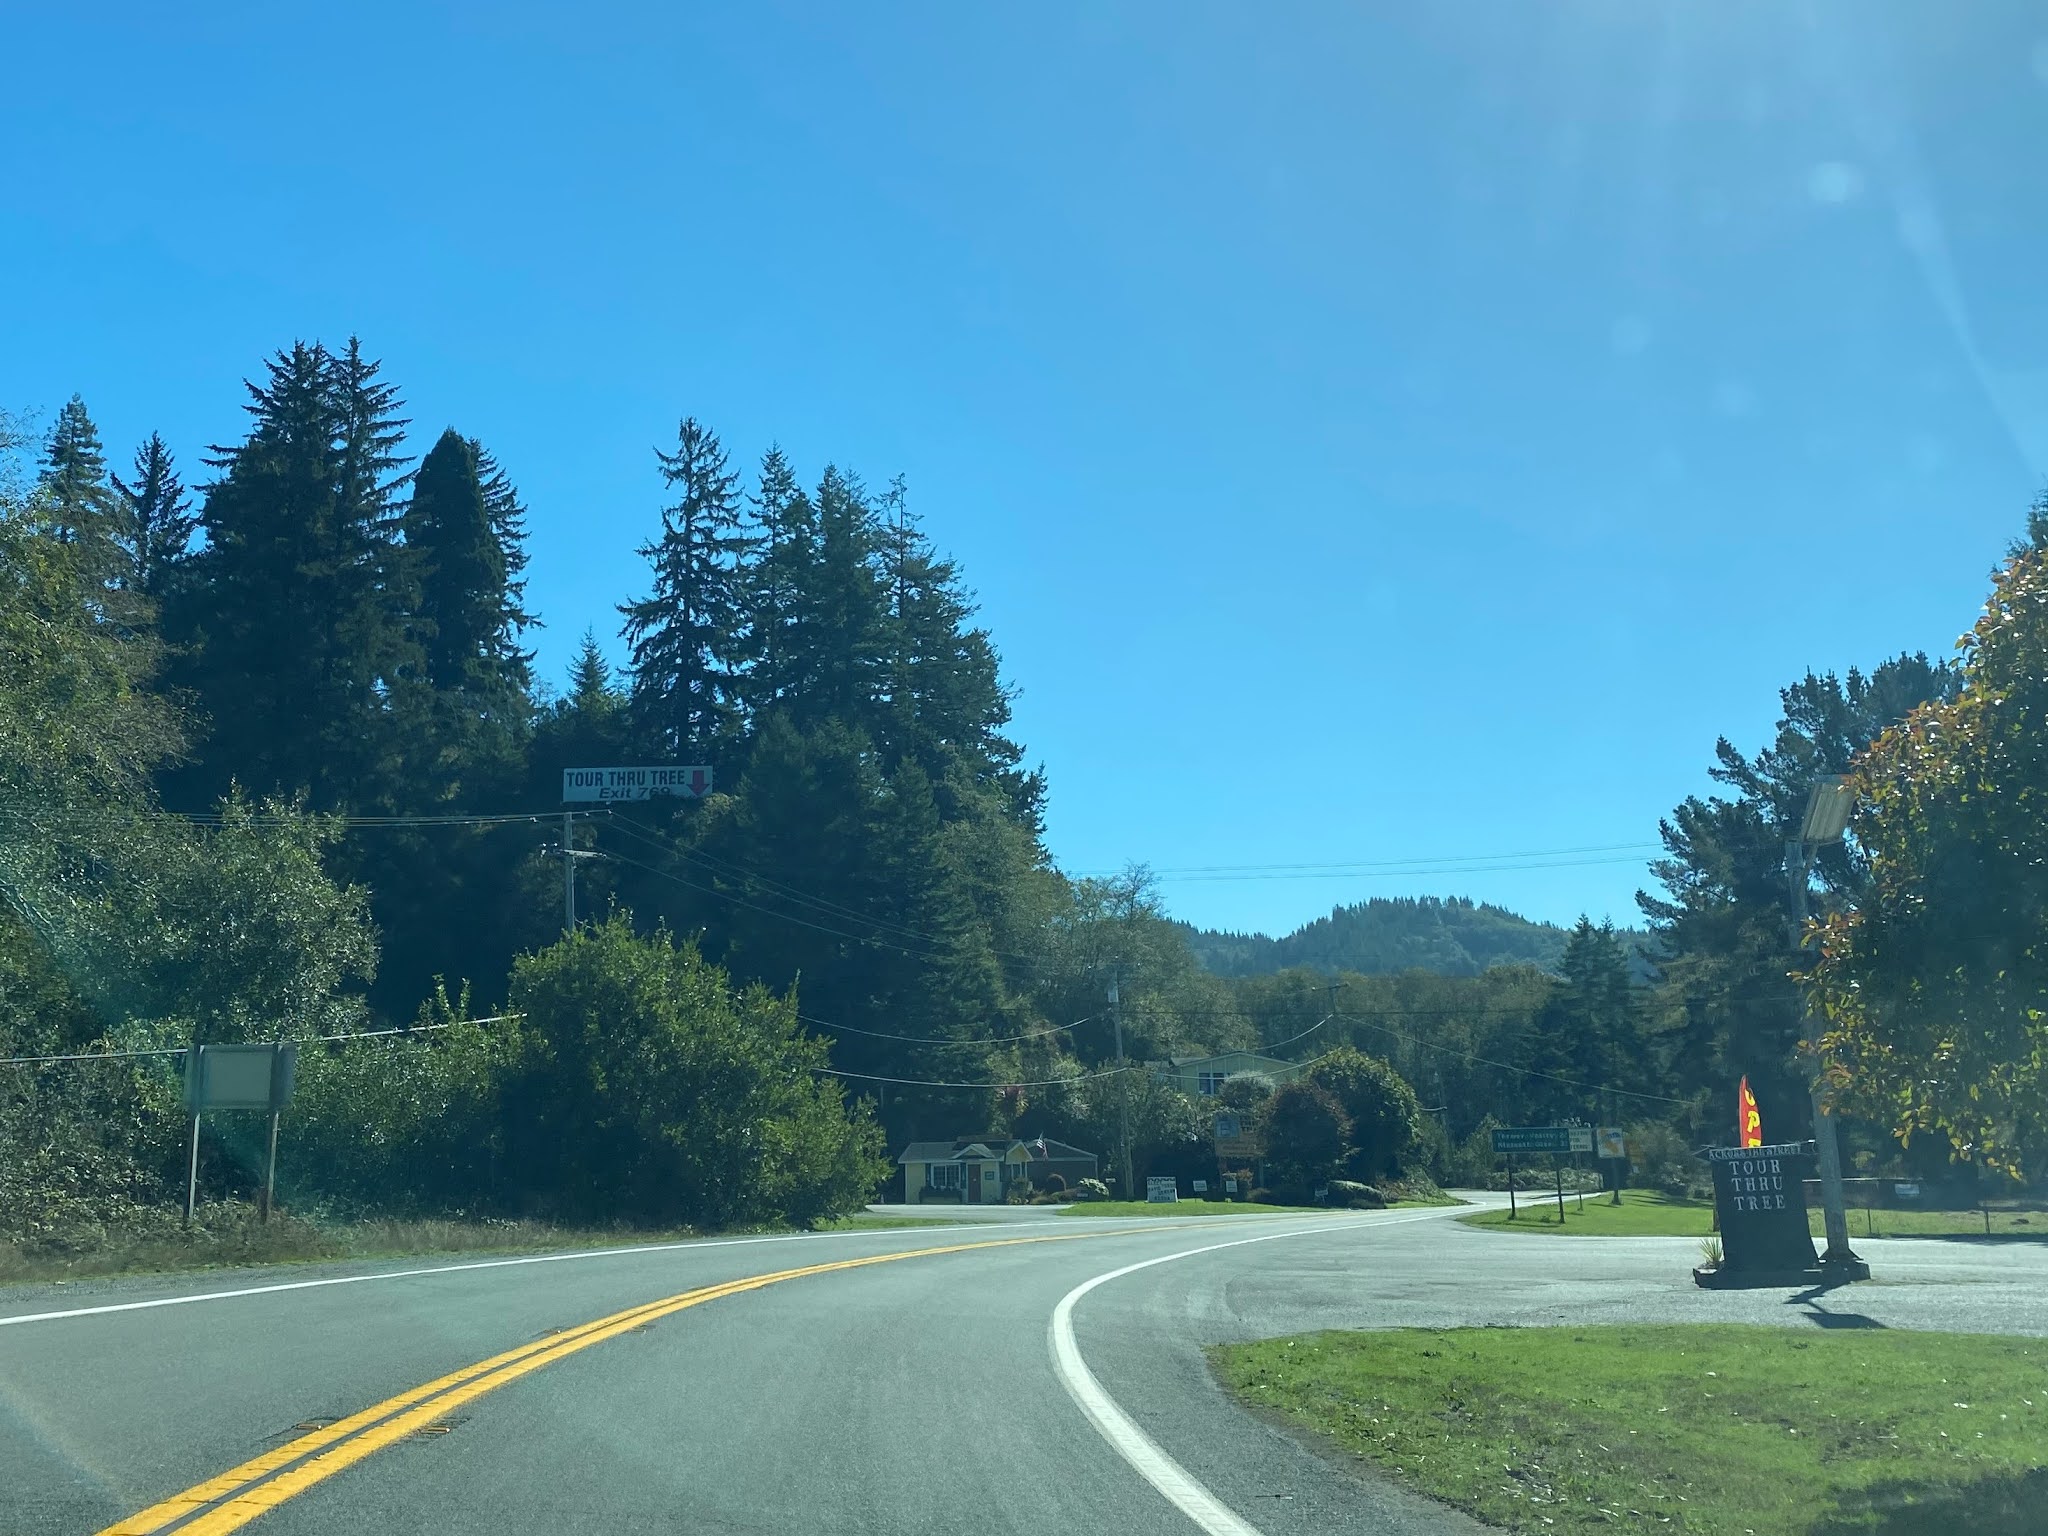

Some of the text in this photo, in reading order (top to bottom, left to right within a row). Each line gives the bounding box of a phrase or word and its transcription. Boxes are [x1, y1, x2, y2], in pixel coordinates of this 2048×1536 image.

[567, 770, 685, 787] TOUR THRU TREE
[599, 787, 632, 799] Exit
[1729, 1160, 1781, 1175] TOUR
[1731, 1176, 1783, 1192] THRU
[1734, 1195, 1786, 1211] TREE
